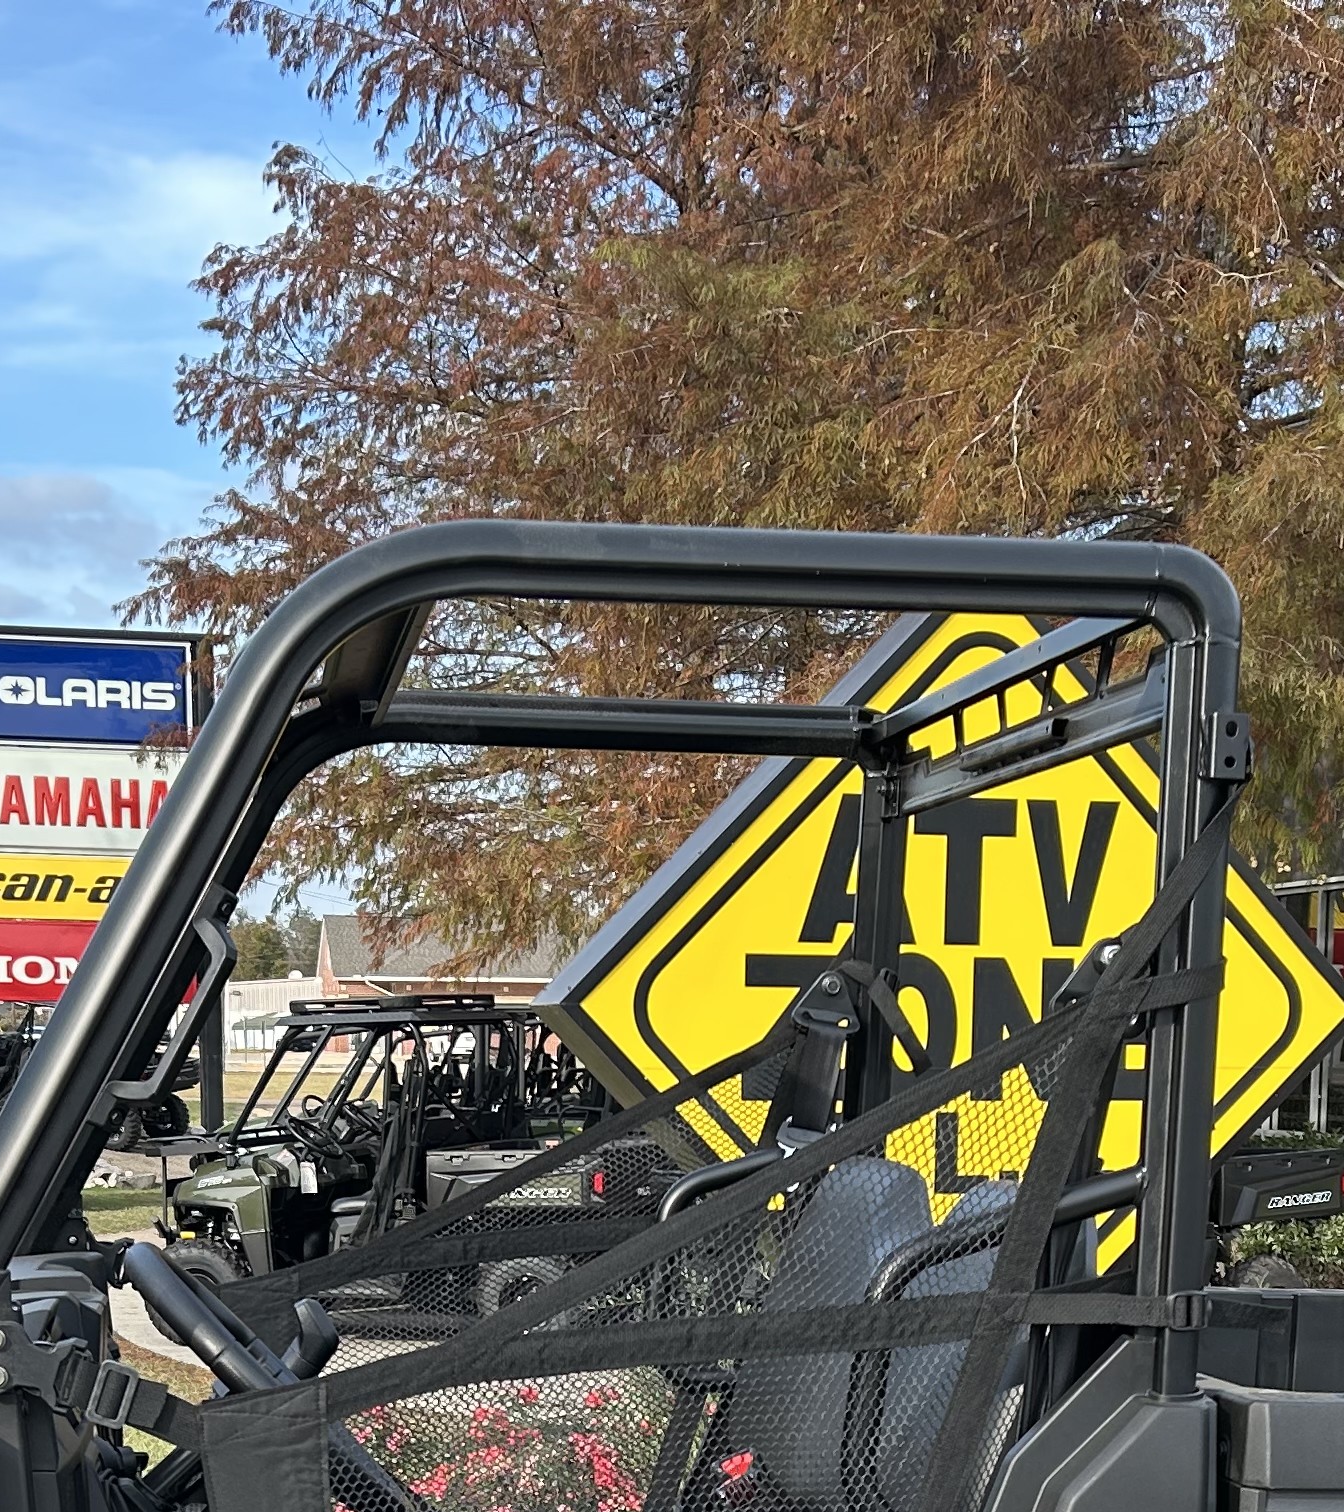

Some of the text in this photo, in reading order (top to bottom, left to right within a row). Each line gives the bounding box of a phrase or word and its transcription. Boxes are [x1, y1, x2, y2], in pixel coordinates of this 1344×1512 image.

[798, 793, 1120, 948] ATV
[743, 953, 1145, 1101] ZON
[1268, 1191, 1332, 1208] RANGER
